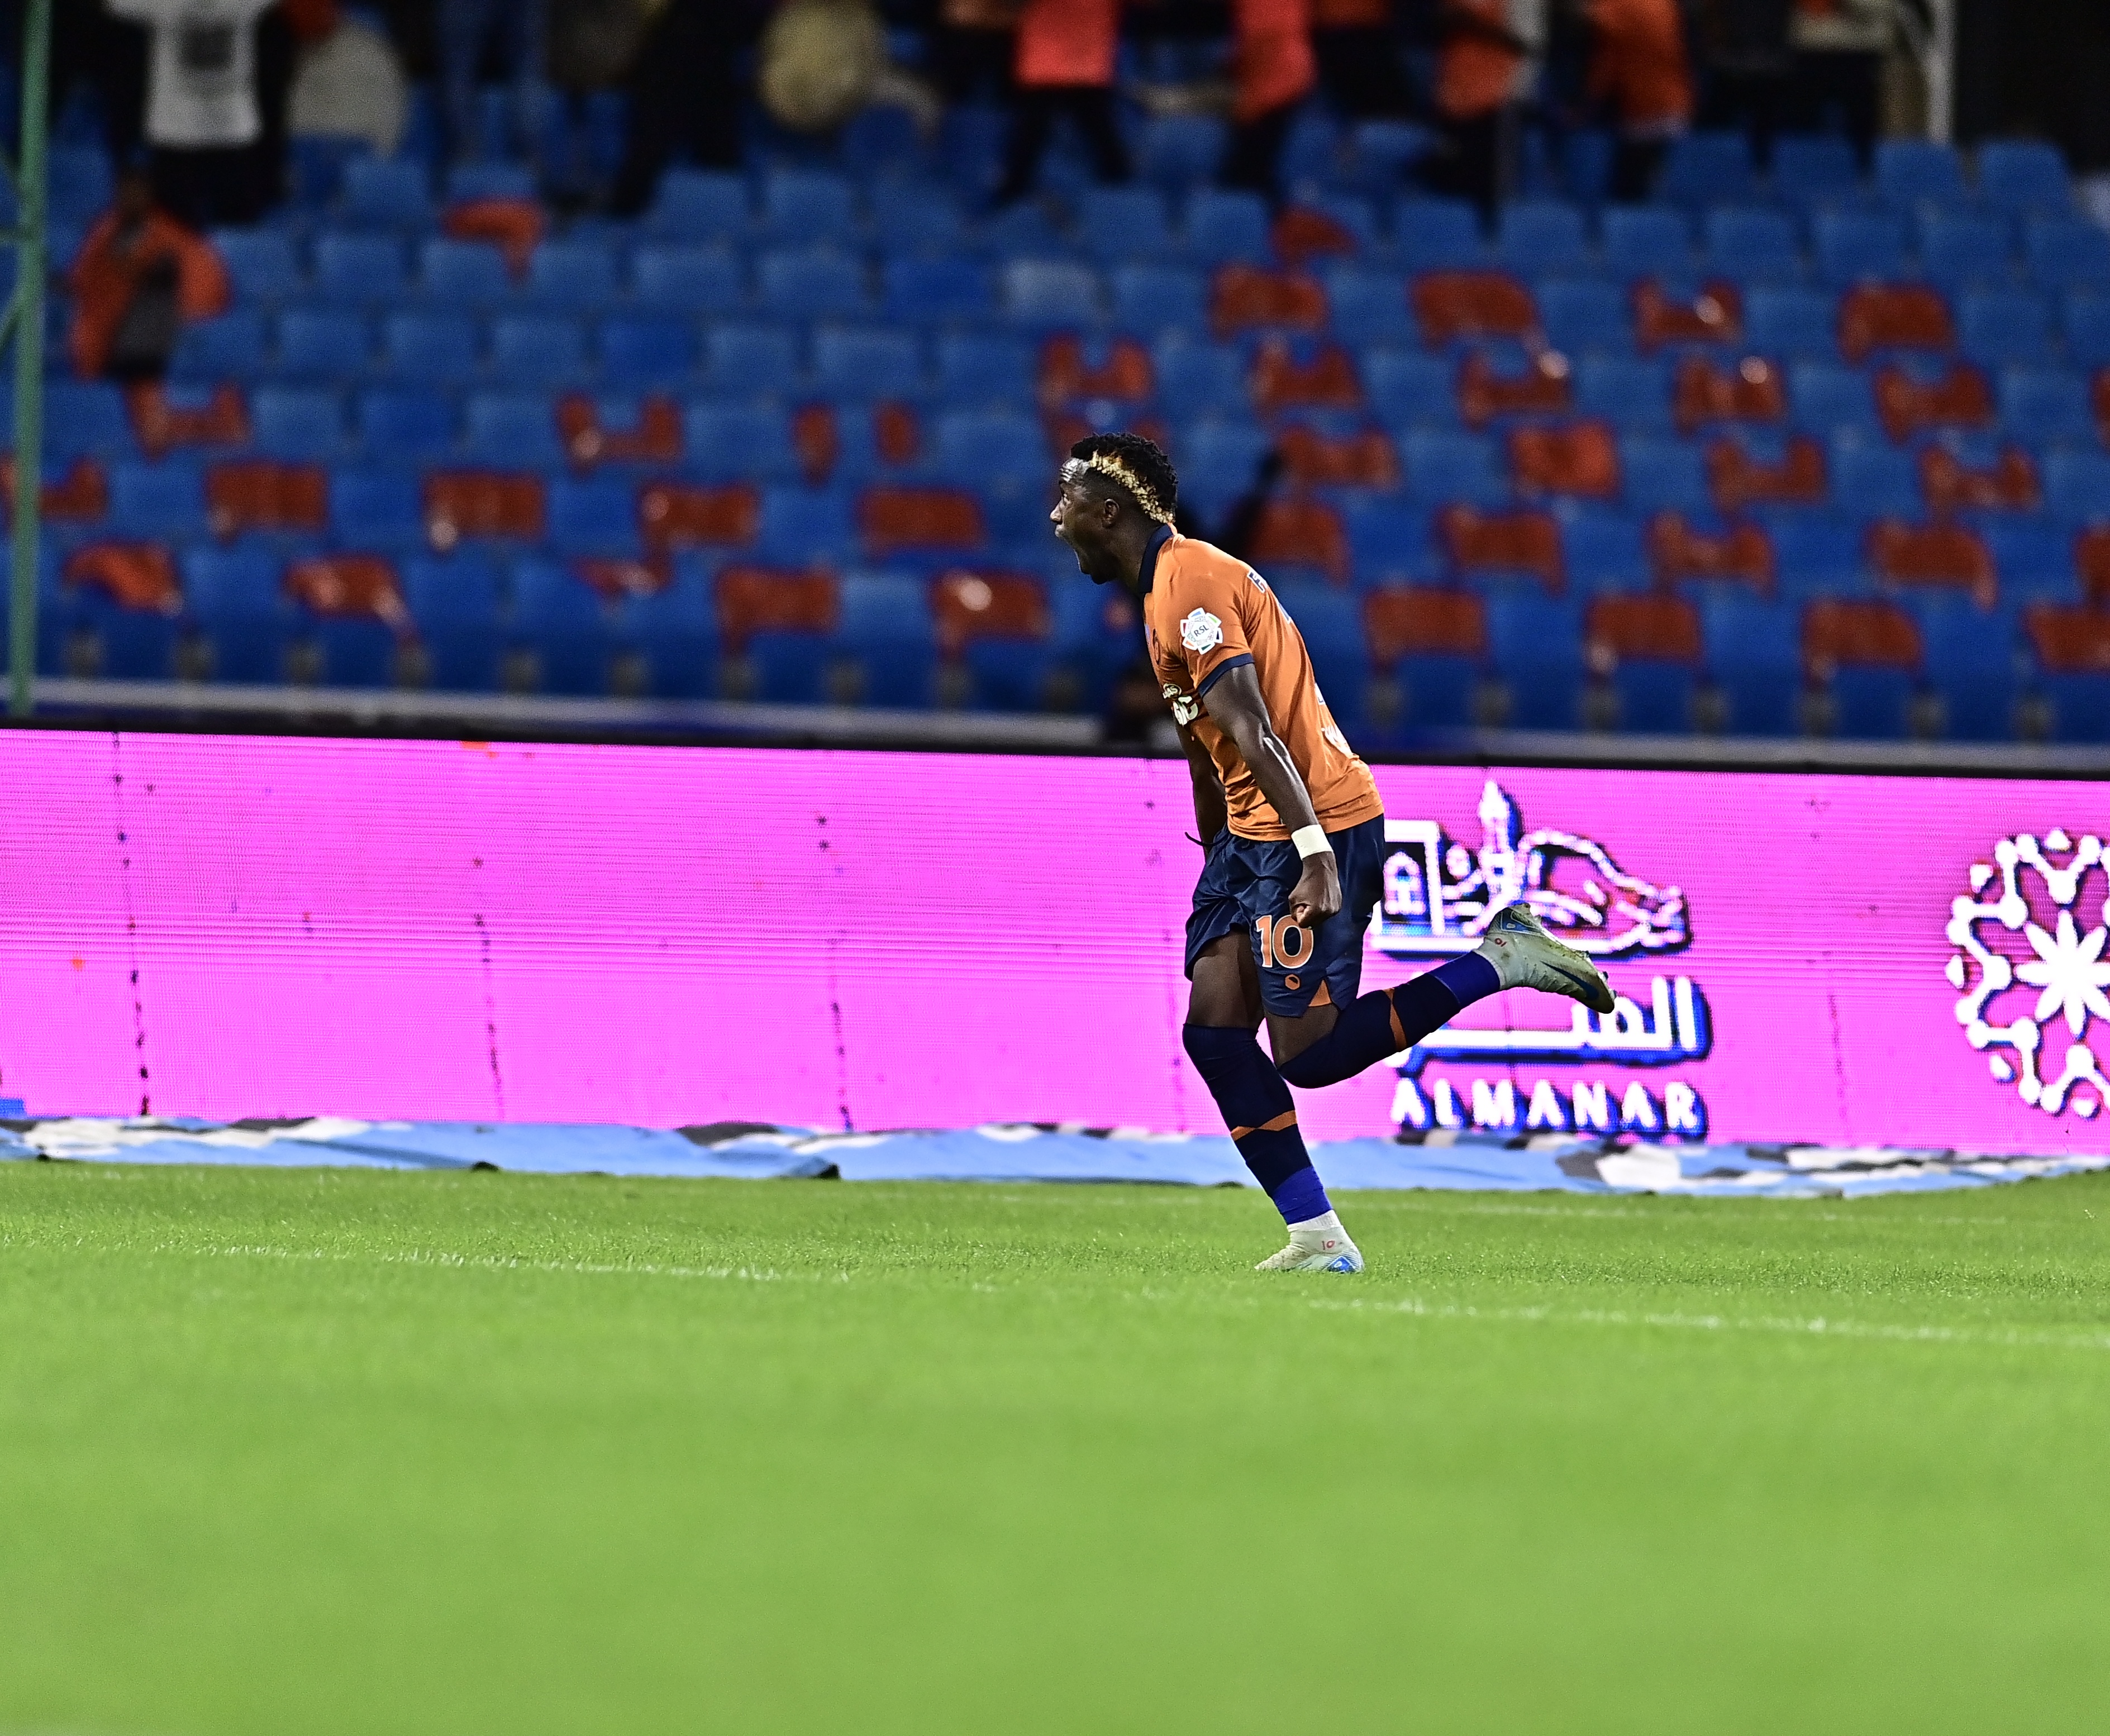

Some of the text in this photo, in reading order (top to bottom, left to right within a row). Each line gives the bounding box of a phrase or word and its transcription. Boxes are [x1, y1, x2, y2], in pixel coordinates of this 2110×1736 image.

[1193, 624, 1209, 637] RSL
[1256, 914, 1314, 969] 10
[1390, 1077, 1699, 1130] ALMANAR
[1322, 1239, 1335, 1251] 10
